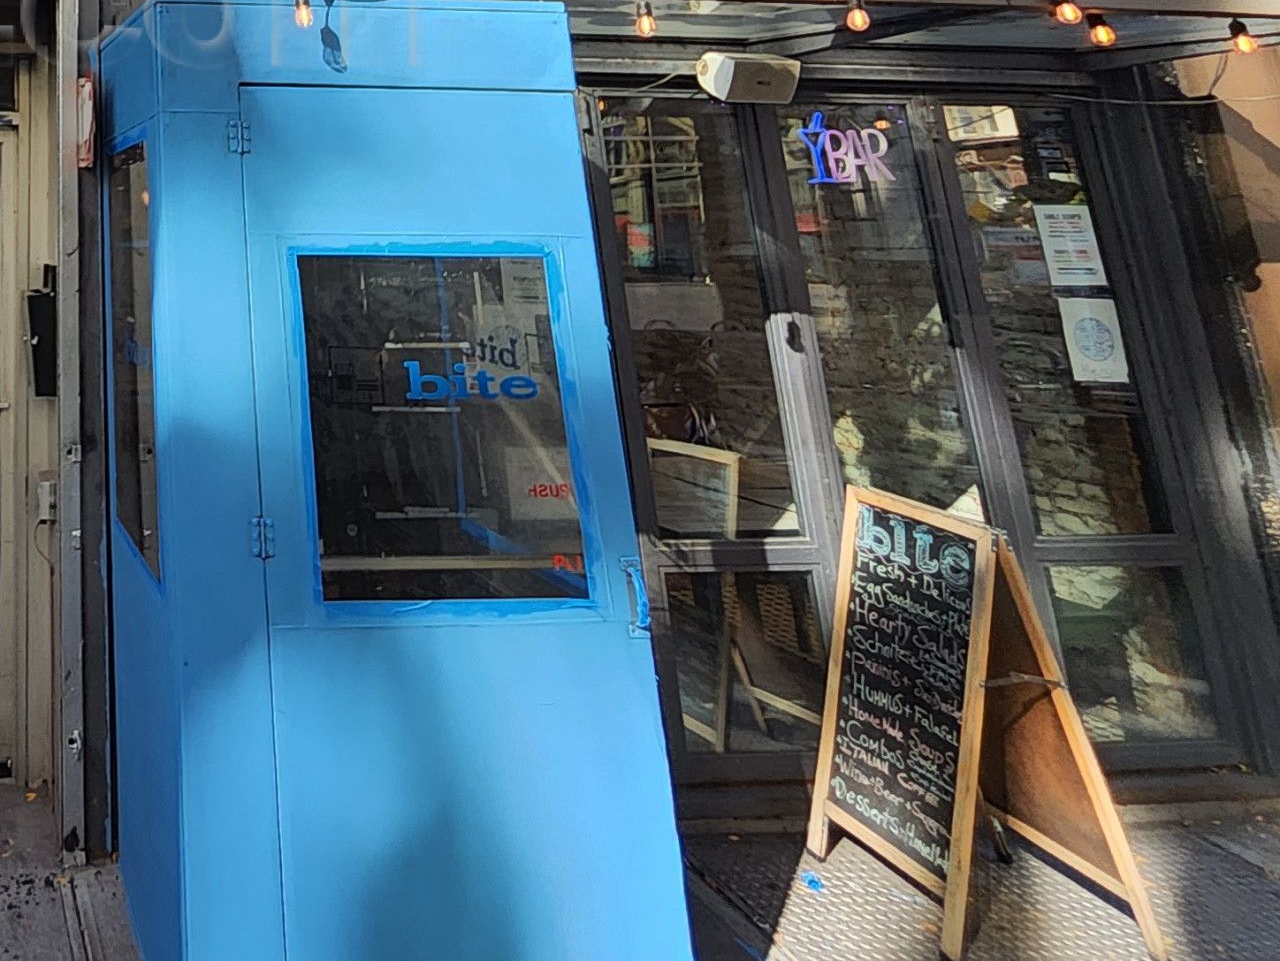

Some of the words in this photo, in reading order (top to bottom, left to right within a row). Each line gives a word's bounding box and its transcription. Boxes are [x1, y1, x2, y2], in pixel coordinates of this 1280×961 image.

[824, 129, 898, 183] BAR
[403, 360, 540, 402] bite
[856, 553, 905, 583] Fresh
[853, 571, 885, 609] Egg
[856, 597, 911, 647] Hearty
